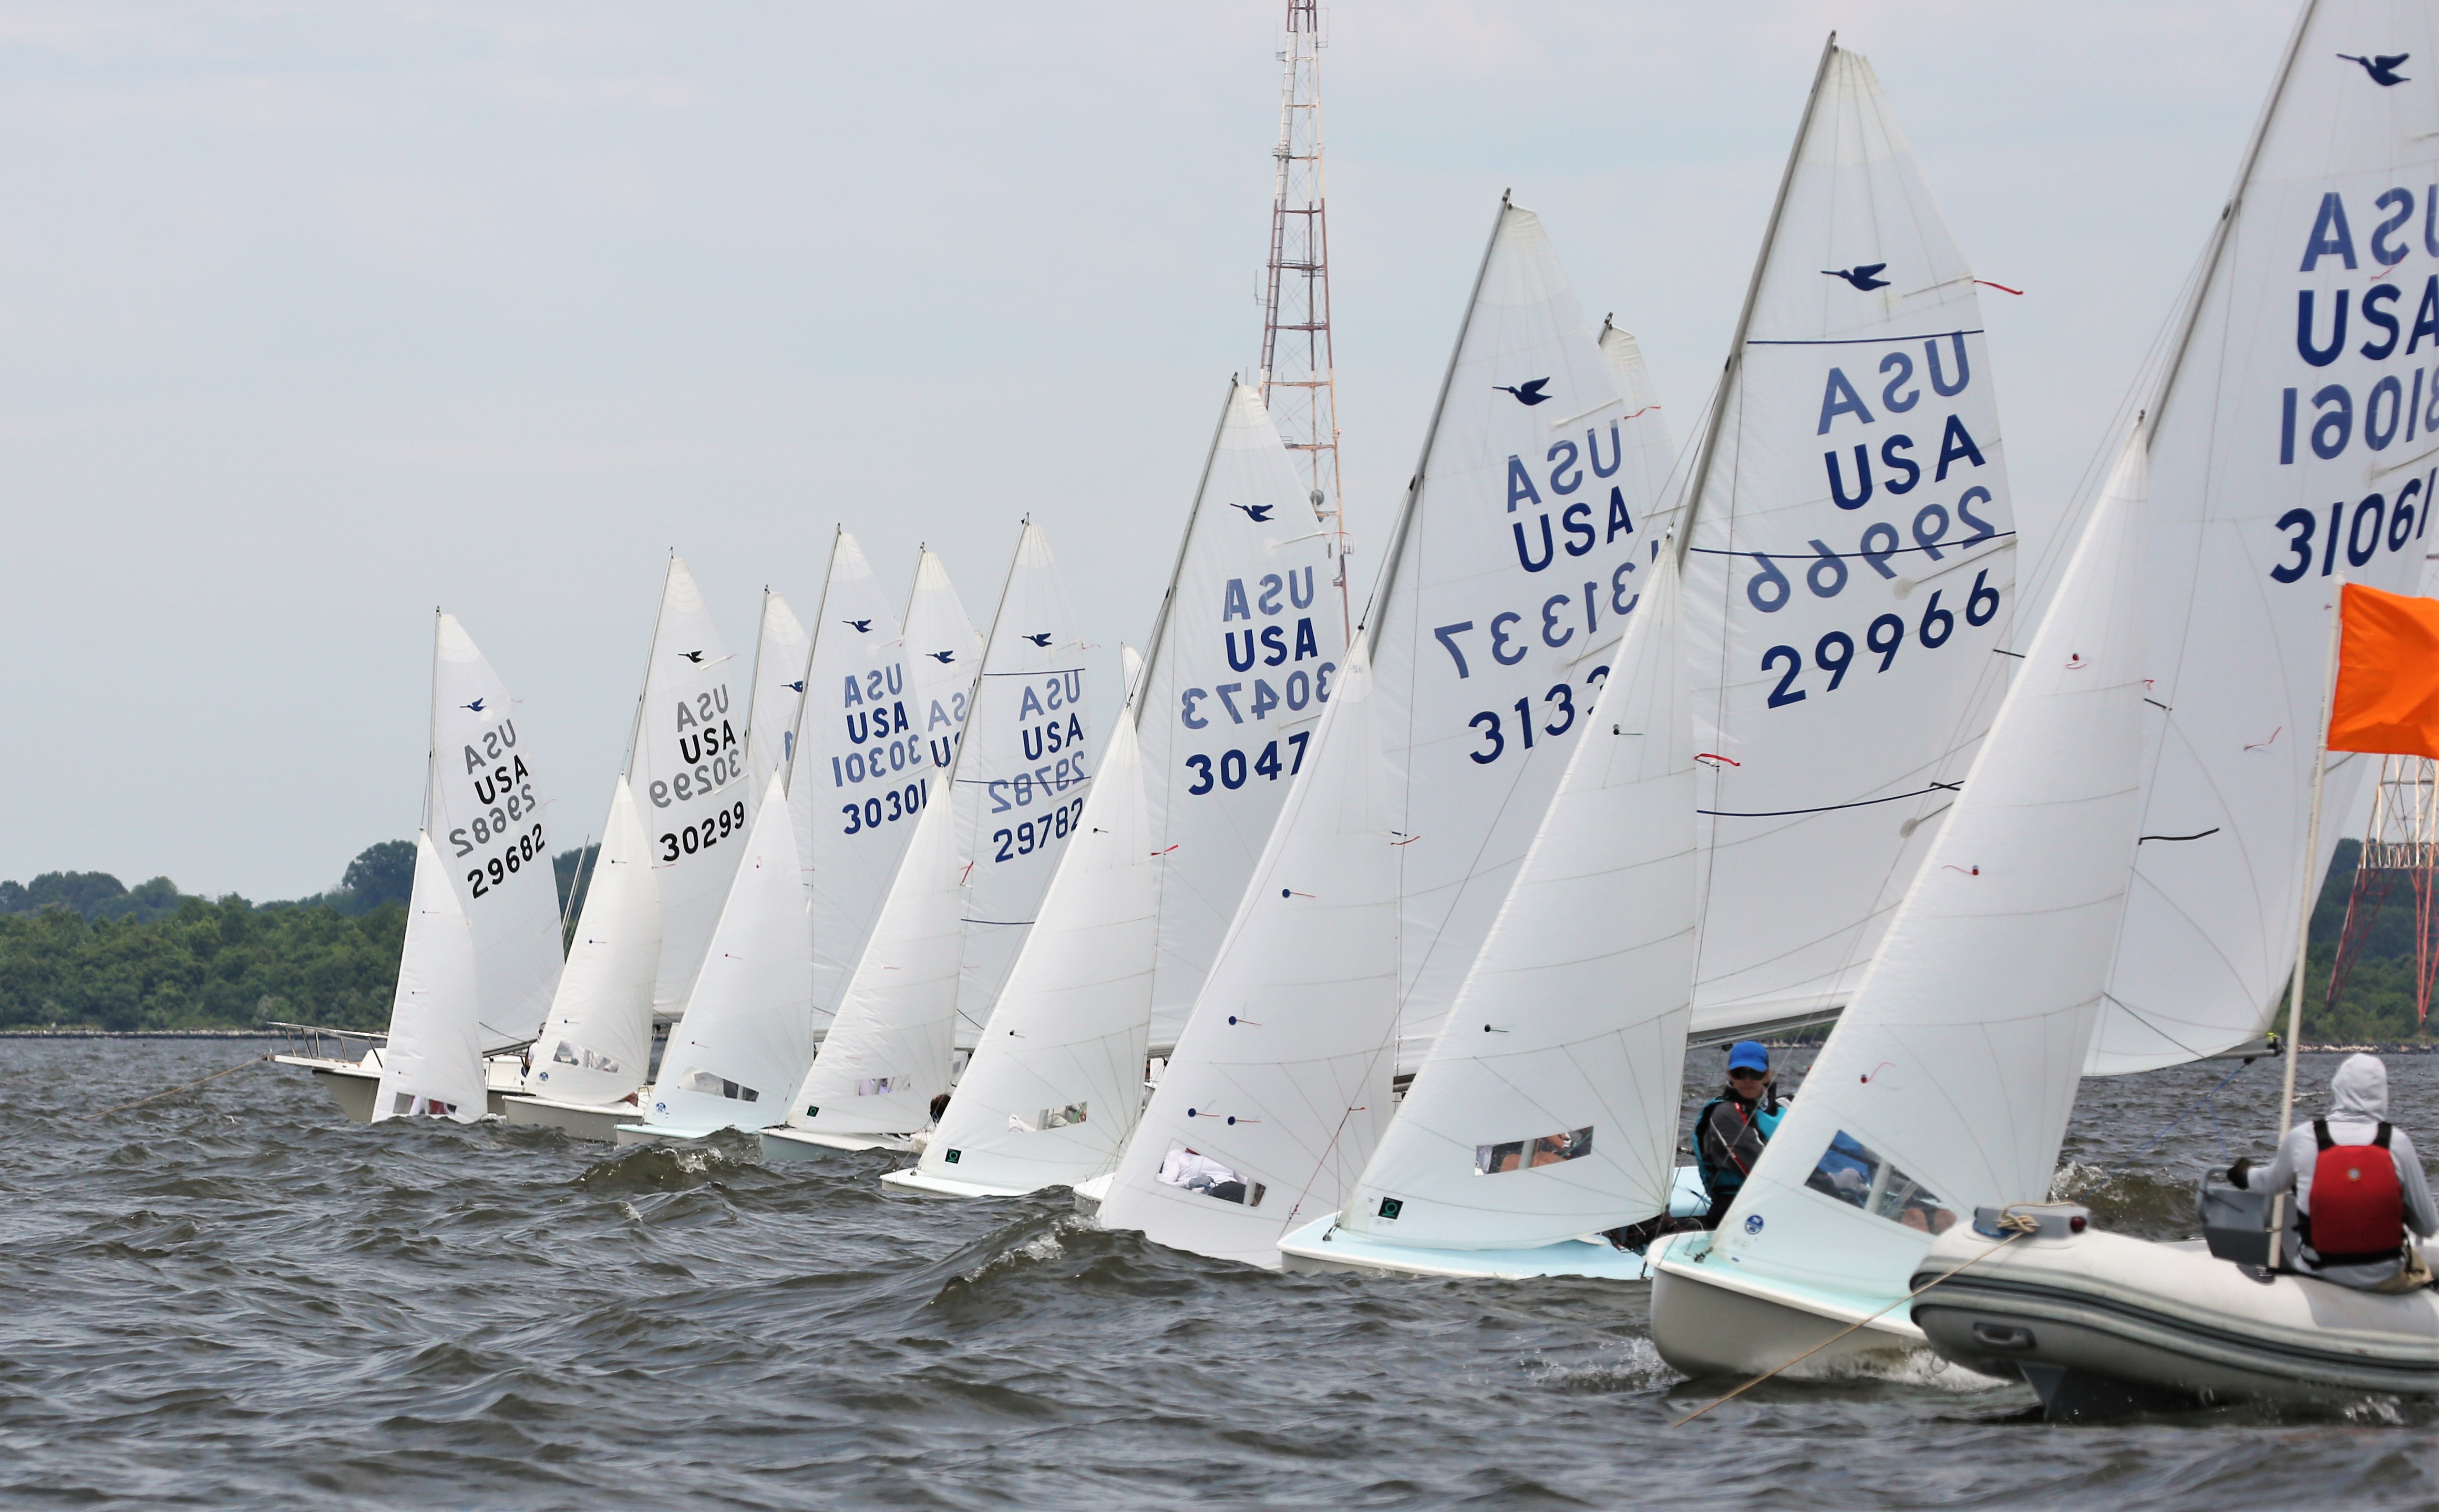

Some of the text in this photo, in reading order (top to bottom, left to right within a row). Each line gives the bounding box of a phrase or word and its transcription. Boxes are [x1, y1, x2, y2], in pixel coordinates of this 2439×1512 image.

[2296, 274, 2439, 368] USA
[1824, 414, 1987, 510] USA
[1512, 486, 1634, 573] USA
[2270, 468, 2437, 584] 31061
[1225, 617, 1319, 672] USA
[1761, 568, 2000, 709] 29966
[680, 719, 736, 764] USA
[846, 701, 909, 744] USA
[930, 732, 960, 767] U
[1022, 713, 1084, 760] USA
[475, 754, 528, 805] USA
[1185, 731, 1310, 796] 3047
[660, 801, 744, 862] 30299
[842, 778, 927, 835] 30301
[993, 797, 1083, 863] 29782
[467, 823, 545, 899] 29682
